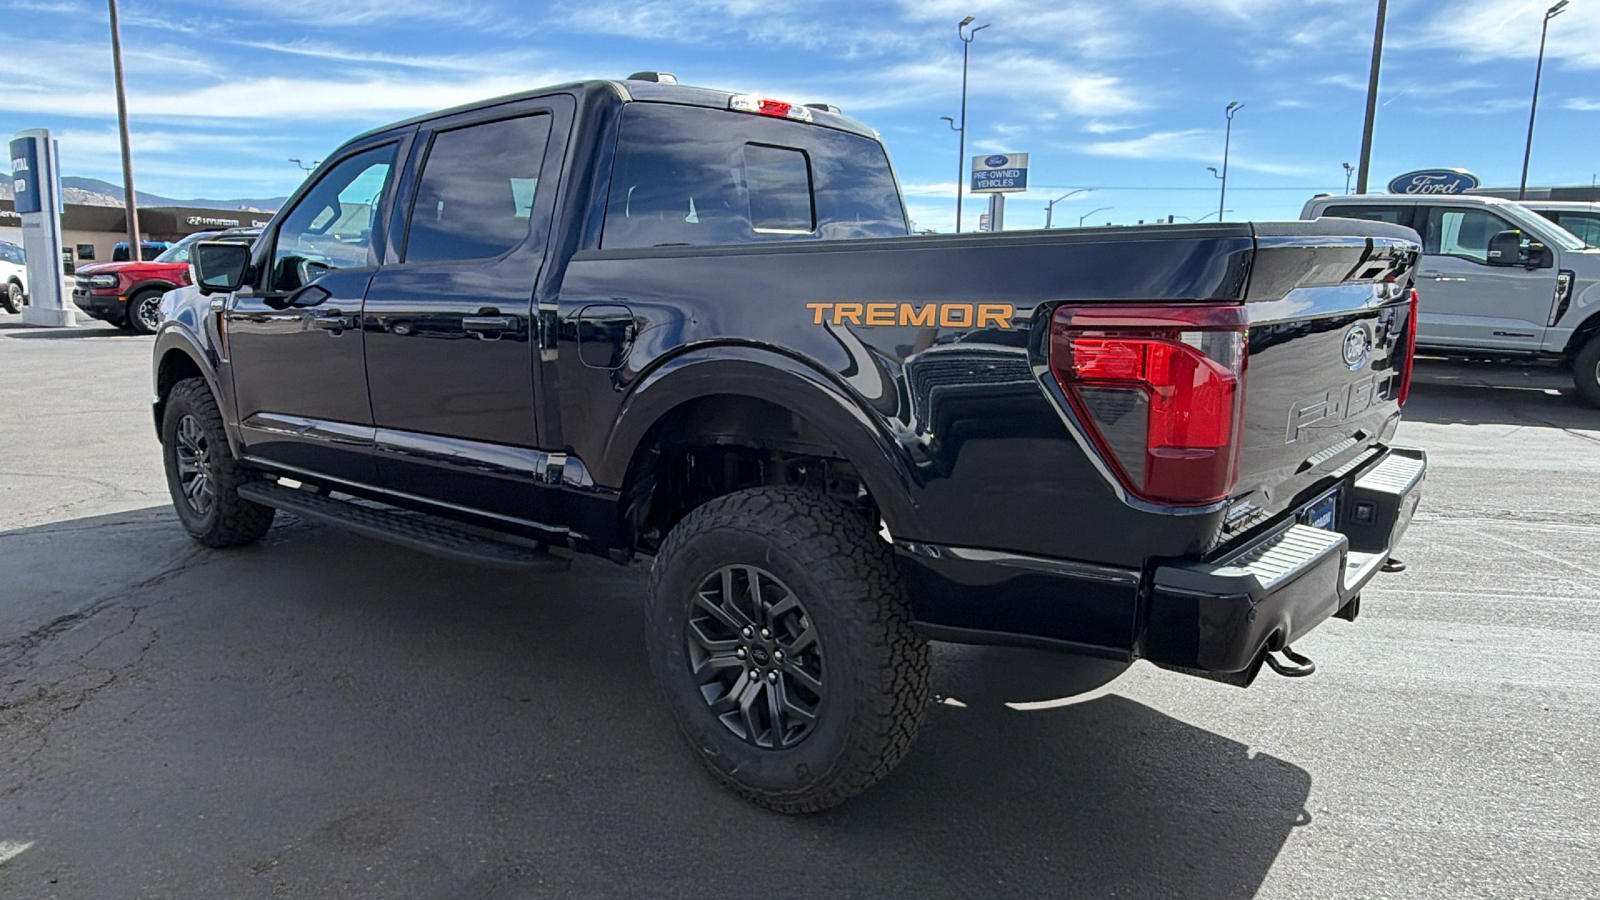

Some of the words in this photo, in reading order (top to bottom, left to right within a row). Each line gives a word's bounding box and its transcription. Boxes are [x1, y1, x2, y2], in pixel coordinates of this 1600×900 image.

[973, 169, 1020, 180] PRE-OWNED
[977, 179, 1014, 188] VEHICLES
[1405, 175, 1461, 194] Ford
[805, 303, 1014, 329] TREMOR
